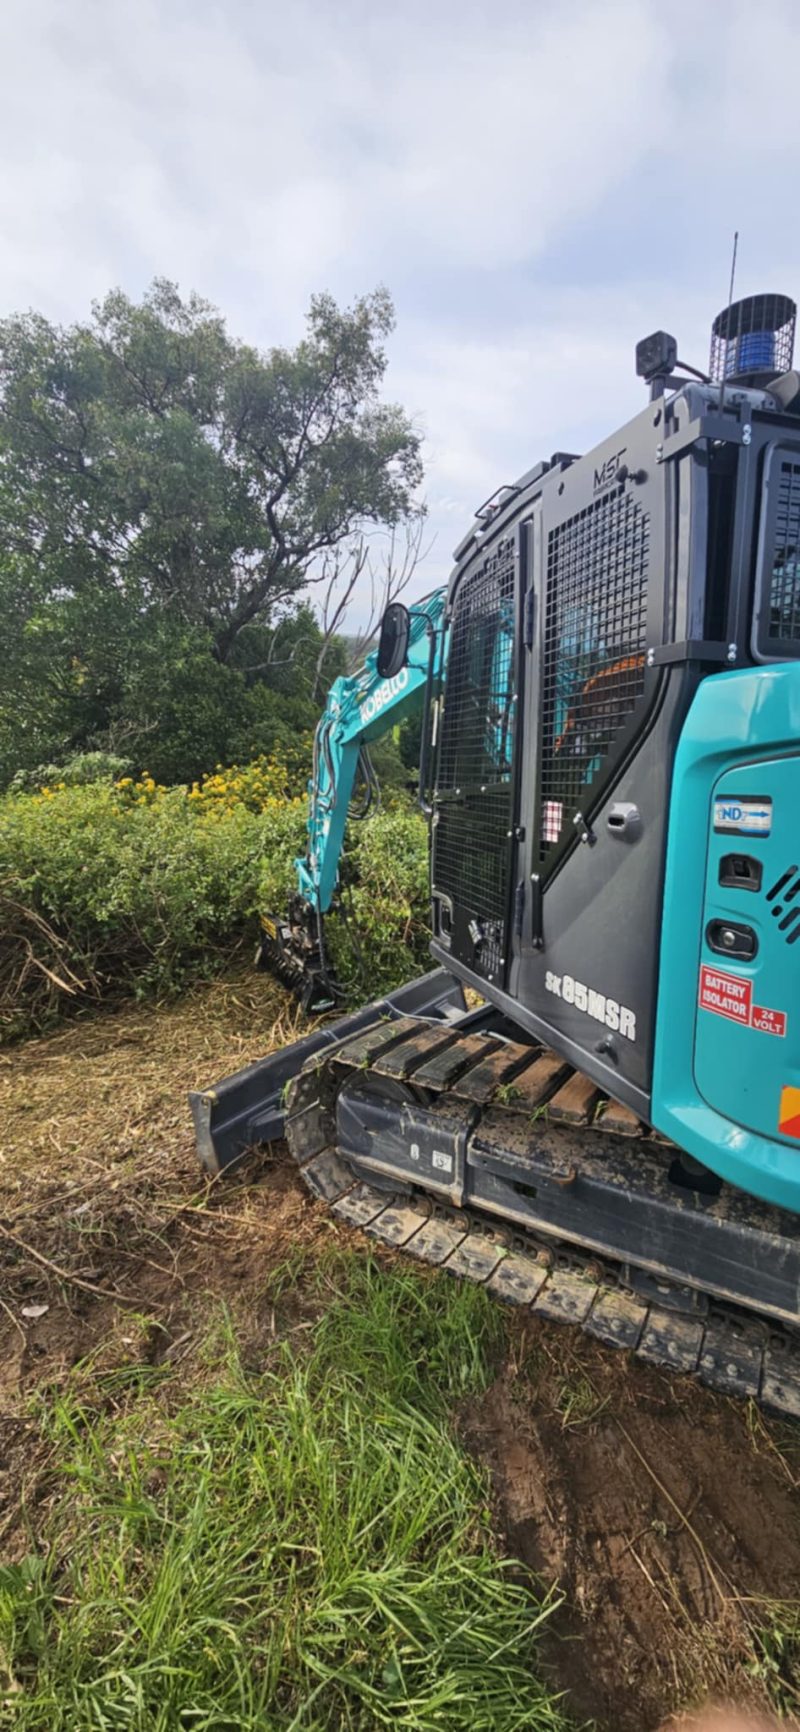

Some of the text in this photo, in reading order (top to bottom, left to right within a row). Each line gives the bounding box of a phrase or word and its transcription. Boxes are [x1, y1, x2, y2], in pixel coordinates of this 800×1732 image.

[705, 974, 746, 999] BATTERY
[703, 989, 747, 1016] ISOLATOR
[761, 1010, 775, 1021] 24
[753, 1018, 783, 1034] VOLT
